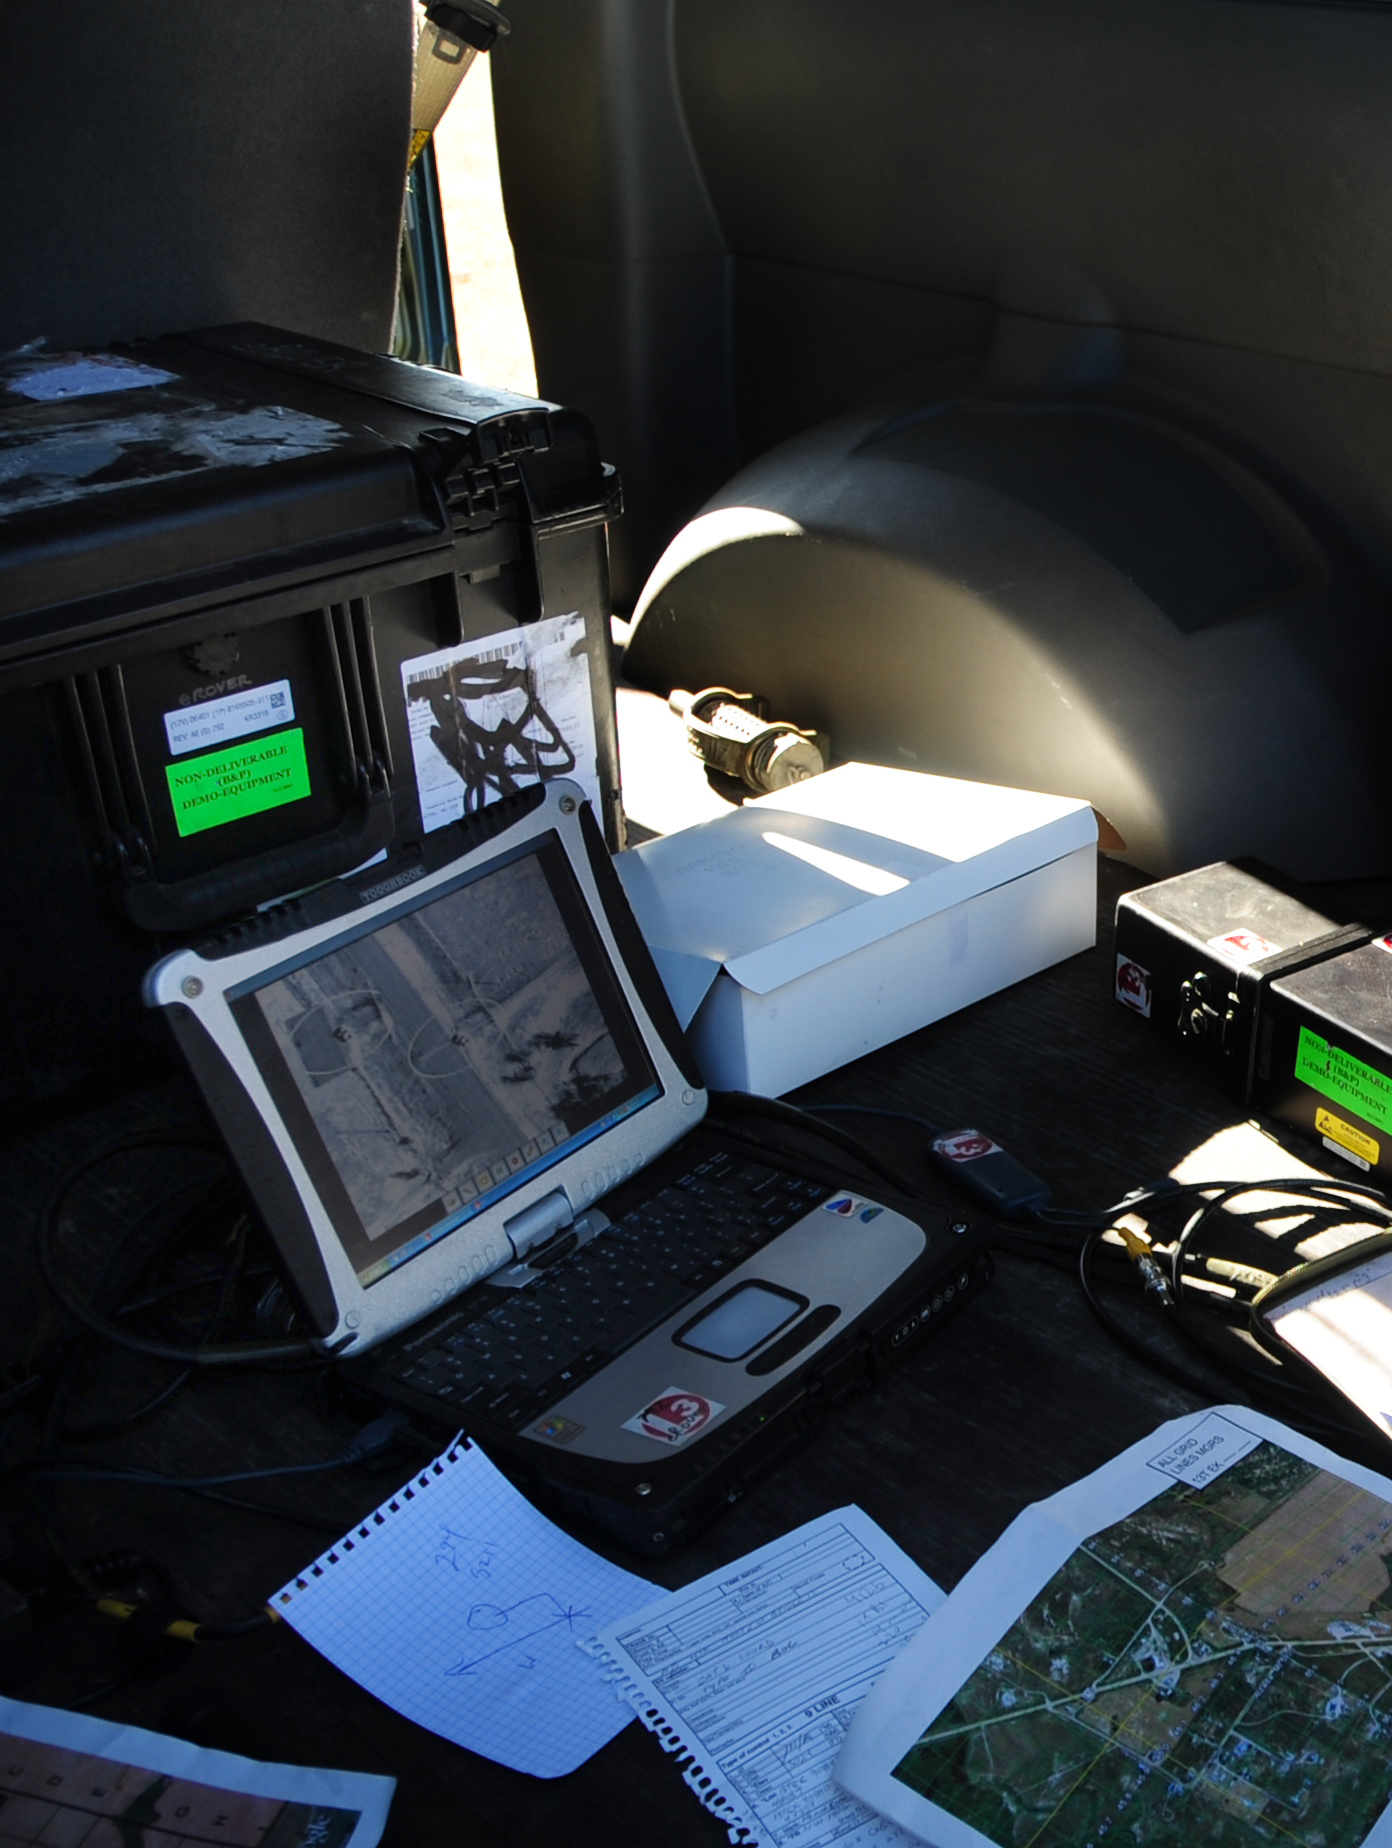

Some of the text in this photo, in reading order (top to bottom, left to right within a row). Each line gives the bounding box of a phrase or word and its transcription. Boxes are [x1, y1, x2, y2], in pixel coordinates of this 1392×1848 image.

[175, 745, 288, 787] NON-DELIVERABLE
[217, 769, 252, 787] (B&P)
[182, 767, 292, 810] DEMO-EQUIPMENT
[360, 865, 426, 902] TOUGHBOOK
[1304, 1034, 1392, 1094] NON-DELIVERABLE
[1333, 1063, 1361, 1088] (B&P)
[1301, 1056, 1388, 1115] DEMO-EQUIPMENT
[402, 1311, 464, 1351] Panasonic
[1157, 1438, 1199, 1469] ALL GRID
[1170, 1454, 1200, 1475] LINES
[804, 1695, 840, 1718] 9 LINE
[722, 1758, 738, 1770] Type
